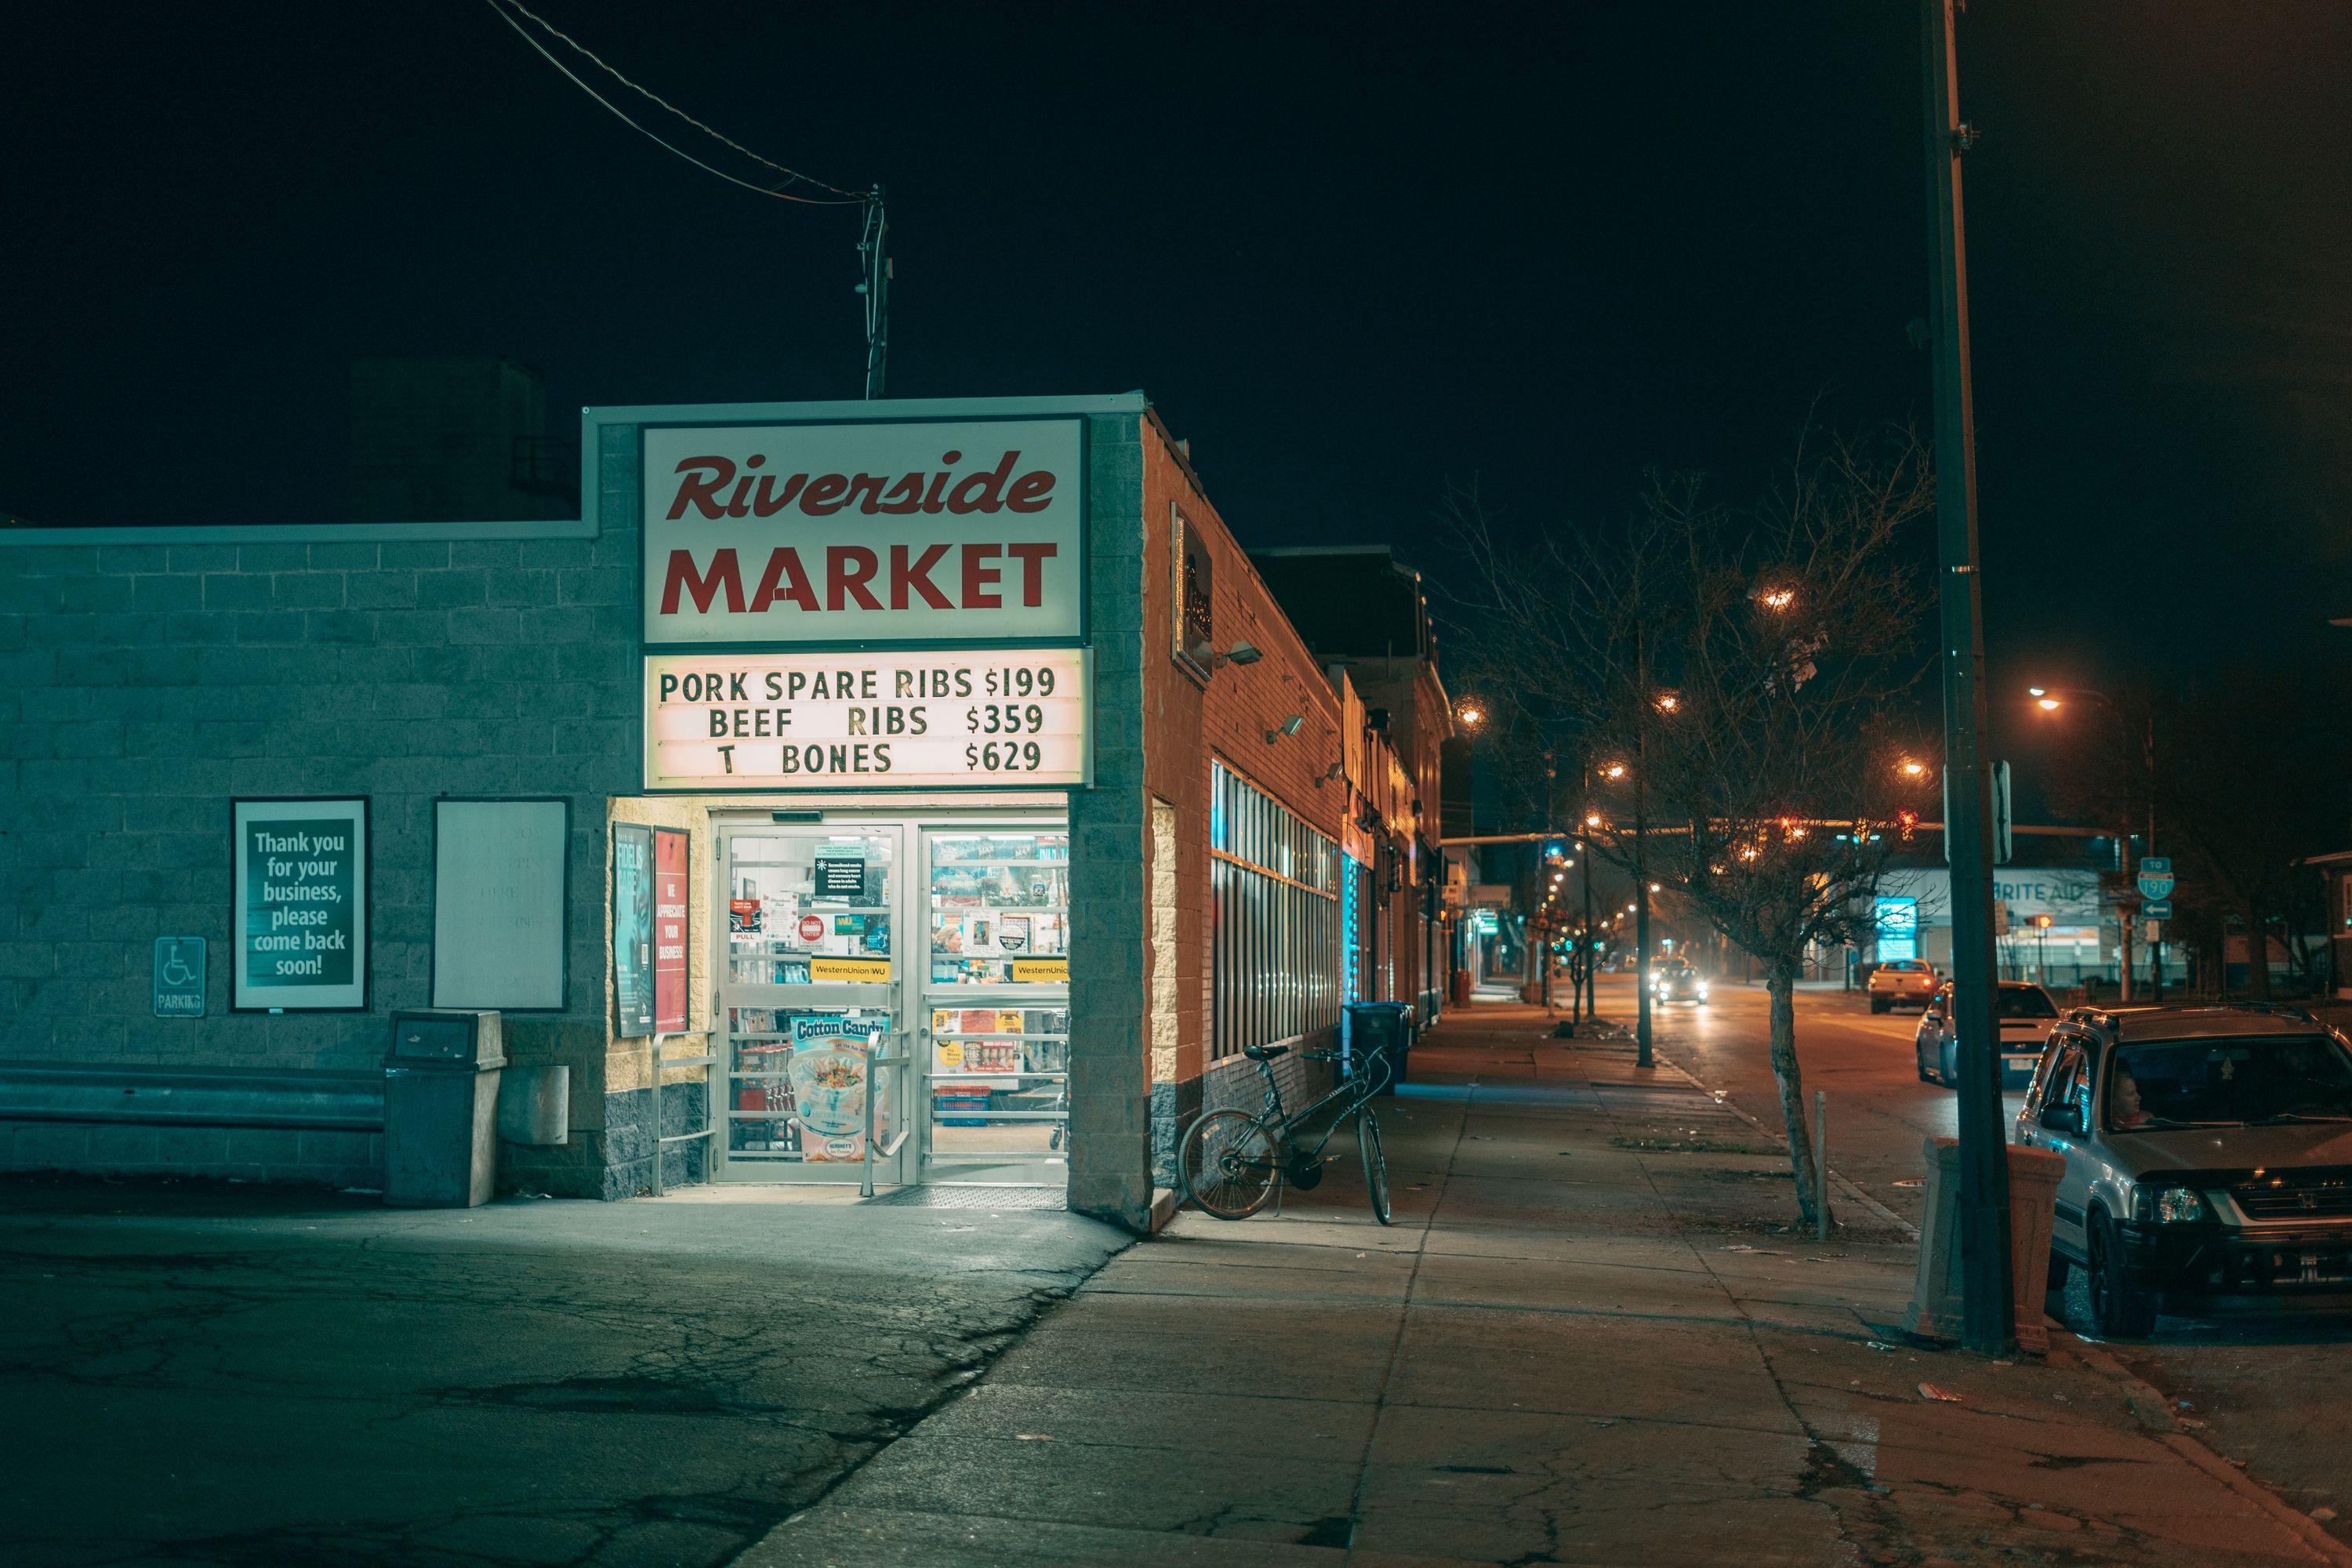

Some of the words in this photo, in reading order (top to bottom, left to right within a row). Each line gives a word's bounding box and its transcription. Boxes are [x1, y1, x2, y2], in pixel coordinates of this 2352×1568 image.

[666, 450, 1056, 521] Riverside
[659, 543, 1058, 615] MARKET
[660, 672, 749, 702] PORK
[765, 670, 878, 700] SPARE
[895, 669, 973, 699] RIBS
[985, 667, 1055, 697] $199
[710, 708, 793, 738] BEEF
[848, 706, 928, 736] RIBS
[966, 704, 1044, 735] $359
[717, 745, 736, 775] T
[782, 743, 892, 774] BONES
[966, 741, 1042, 771] $629
[256, 832, 308, 853] Thank
[313, 835, 345, 857] you
[617, 843, 643, 870] FIDELIS
[267, 856, 293, 877] for
[297, 860, 338, 880] your
[263, 881, 342, 903] business,
[667, 884, 676, 897] WE
[2050, 884, 2084, 901] AID
[271, 906, 328, 931] please
[657, 904, 685, 918] APPRECIATE
[254, 935, 300, 951] come
[304, 929, 346, 950] back
[665, 925, 679, 939] YOUR
[659, 946, 683, 960] BUSINESS!
[276, 955, 323, 976] soon!
[158, 994, 201, 1010] PARKING
[797, 1020, 840, 1040] Cotton
